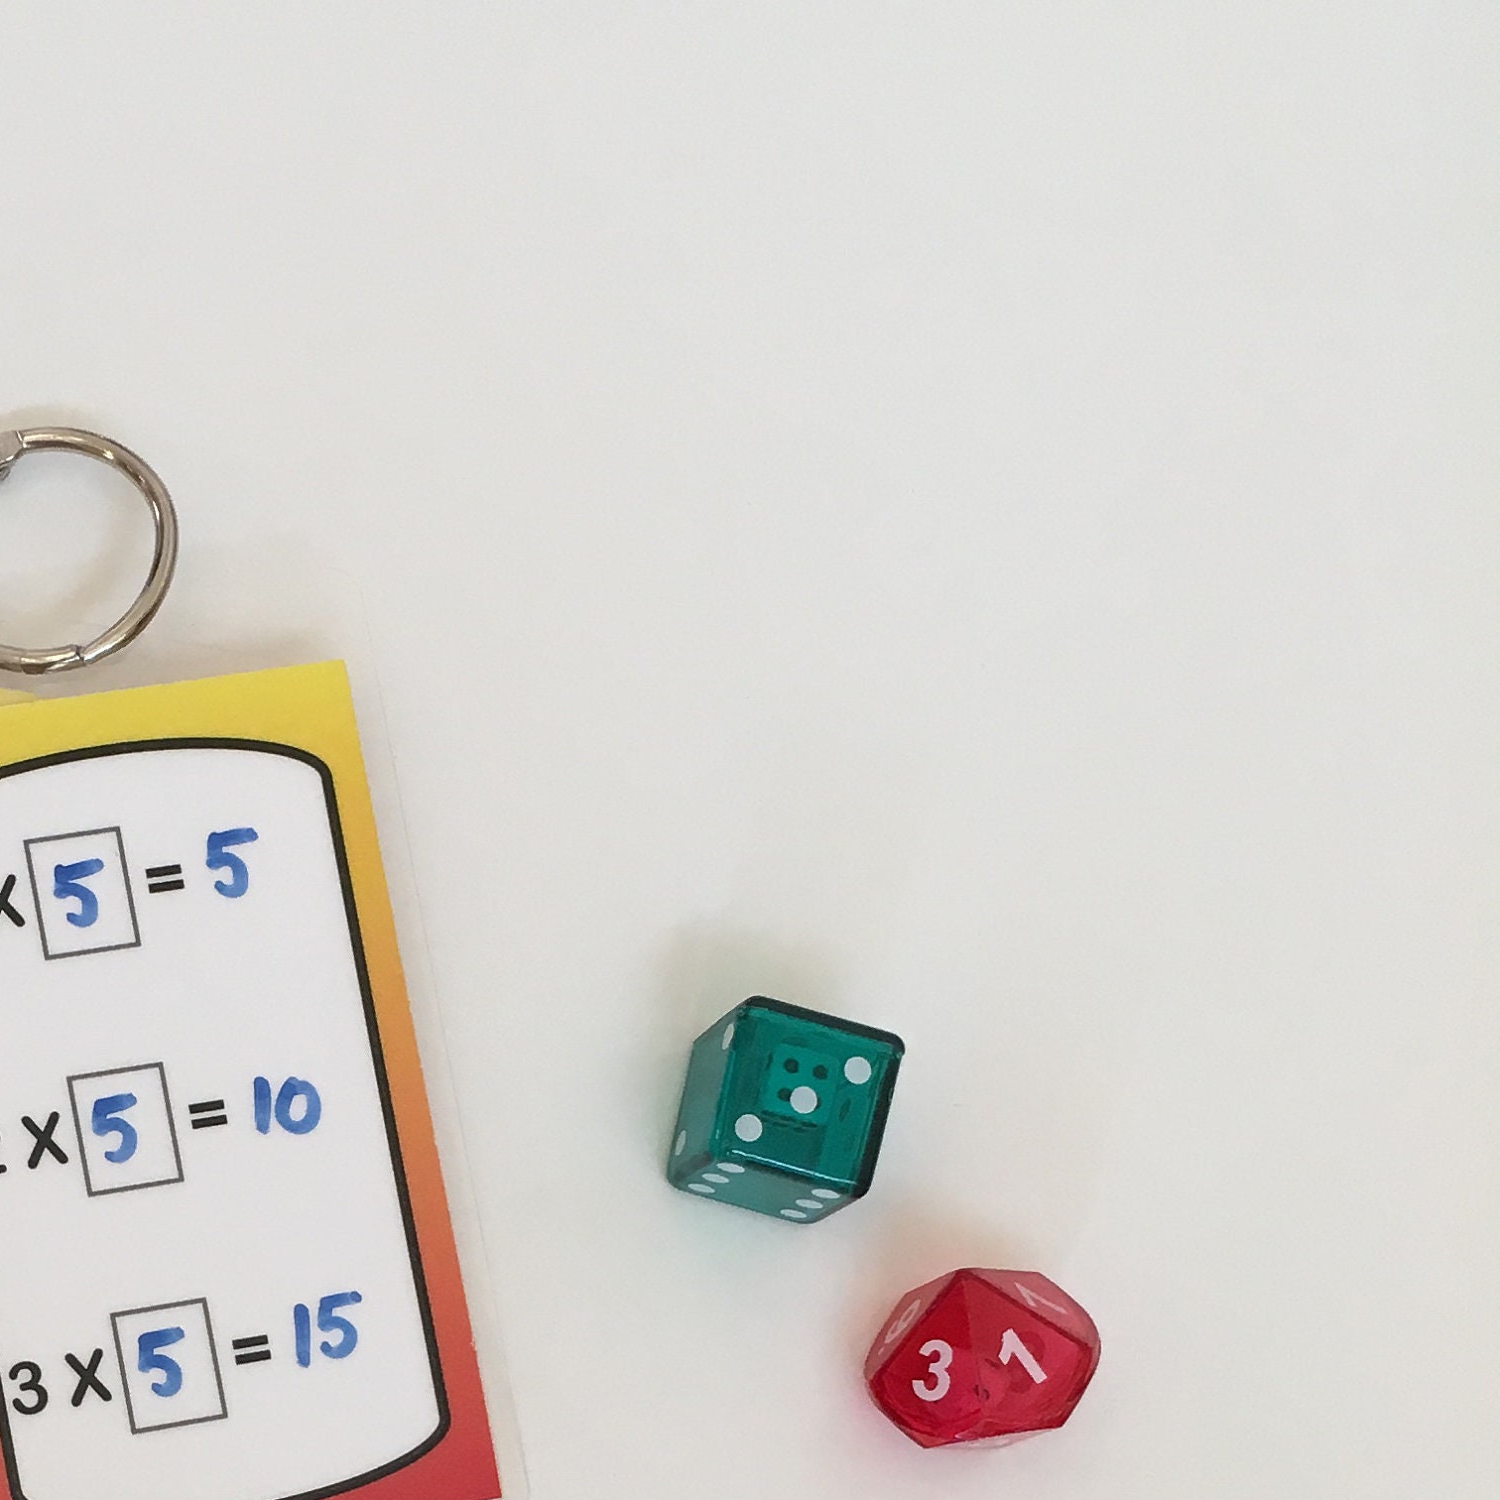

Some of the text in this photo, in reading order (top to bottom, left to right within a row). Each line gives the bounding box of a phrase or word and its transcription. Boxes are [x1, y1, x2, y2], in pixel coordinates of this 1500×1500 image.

[53, 859, 104, 928] 5
[146, 864, 185, 894] =
[206, 828, 258, 899] 5
[92, 1093, 138, 1164] 5
[188, 1100, 228, 1130] =
[254, 1077, 321, 1134] 10
[9, 1361, 49, 1415] 3
[138, 1327, 184, 1398] 5
[232, 1335, 272, 1365] =
[294, 1290, 362, 1368] 15
[911, 1339, 954, 1402] 3
[998, 1327, 1048, 1385] 1
